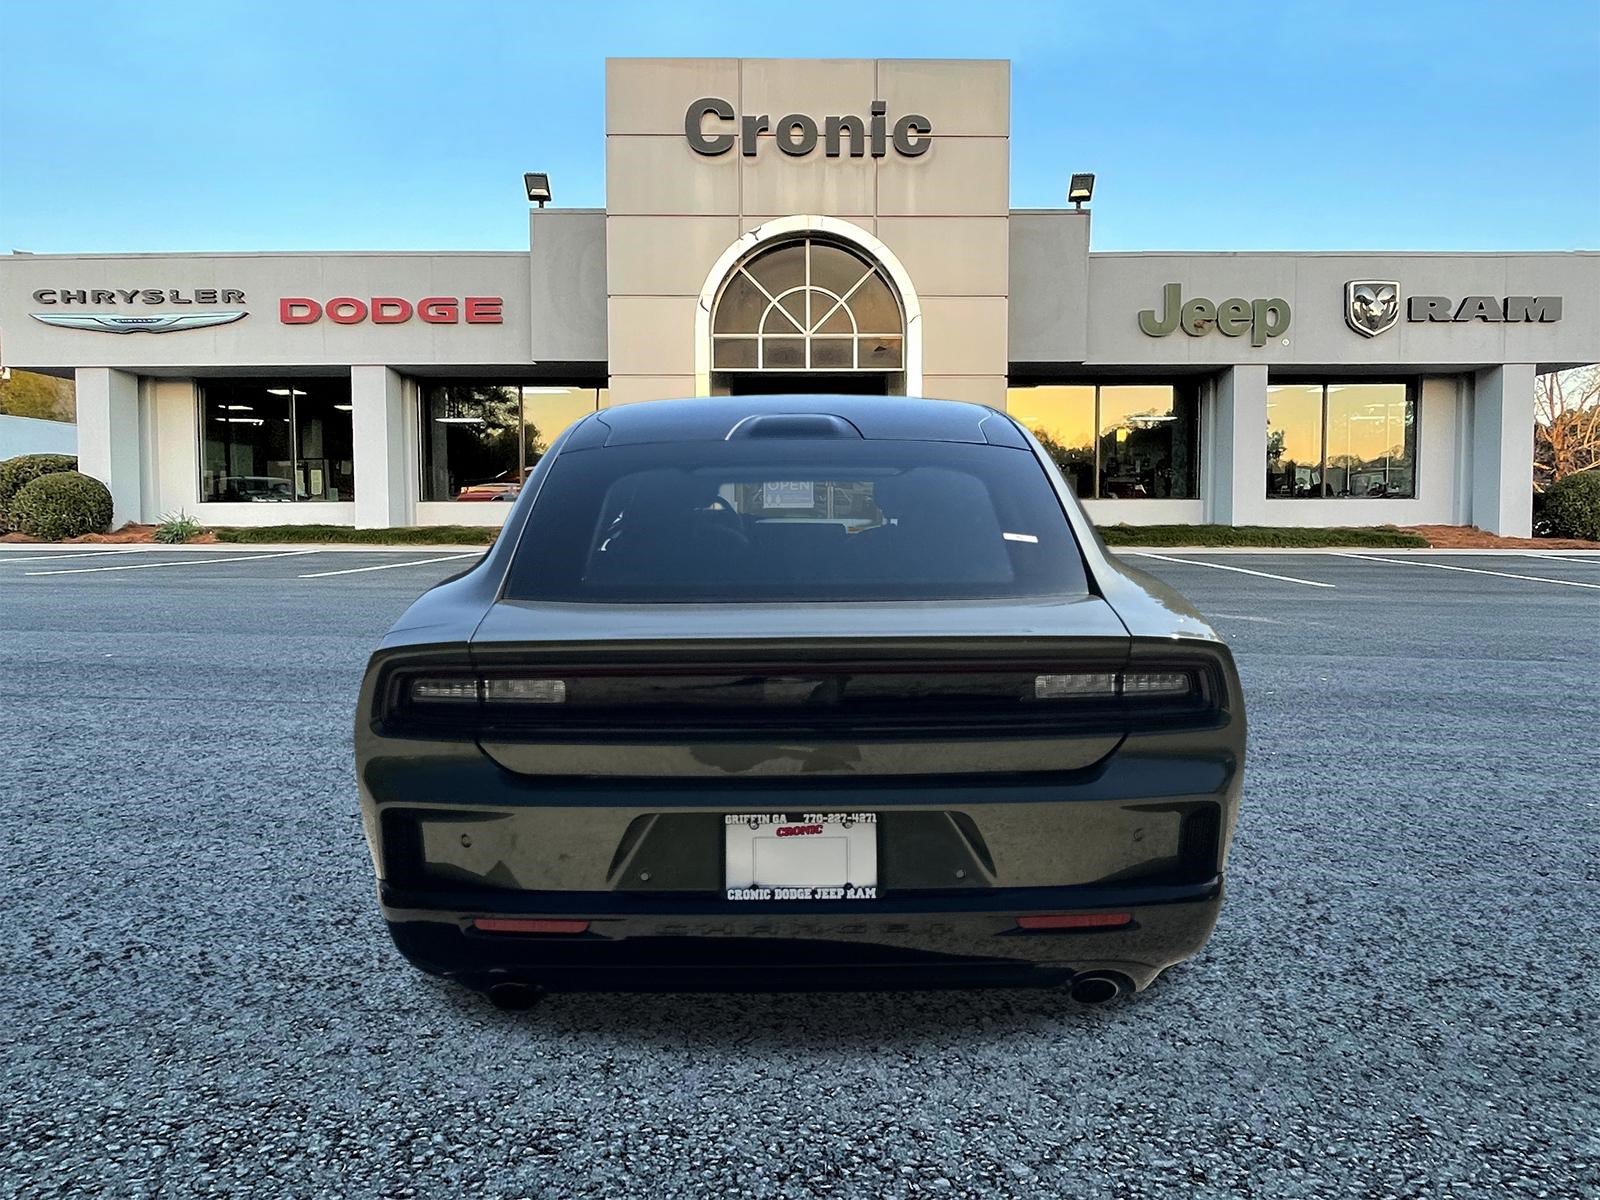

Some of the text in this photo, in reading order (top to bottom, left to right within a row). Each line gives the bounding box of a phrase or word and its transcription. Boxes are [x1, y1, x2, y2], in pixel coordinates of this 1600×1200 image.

[685, 97, 932, 157] Cronic
[33, 289, 246, 304] CHRYSLER
[280, 297, 503, 324] DODGE
[1138, 283, 1291, 346] Jeep
[1407, 296, 1562, 322] RAM
[767, 481, 811, 490] OPEN
[725, 813, 877, 825] GRIFFIN GA 770-227-4271
[776, 824, 823, 837] CRONIC
[727, 887, 877, 900] CRONIC DODGE JEEP RAM
